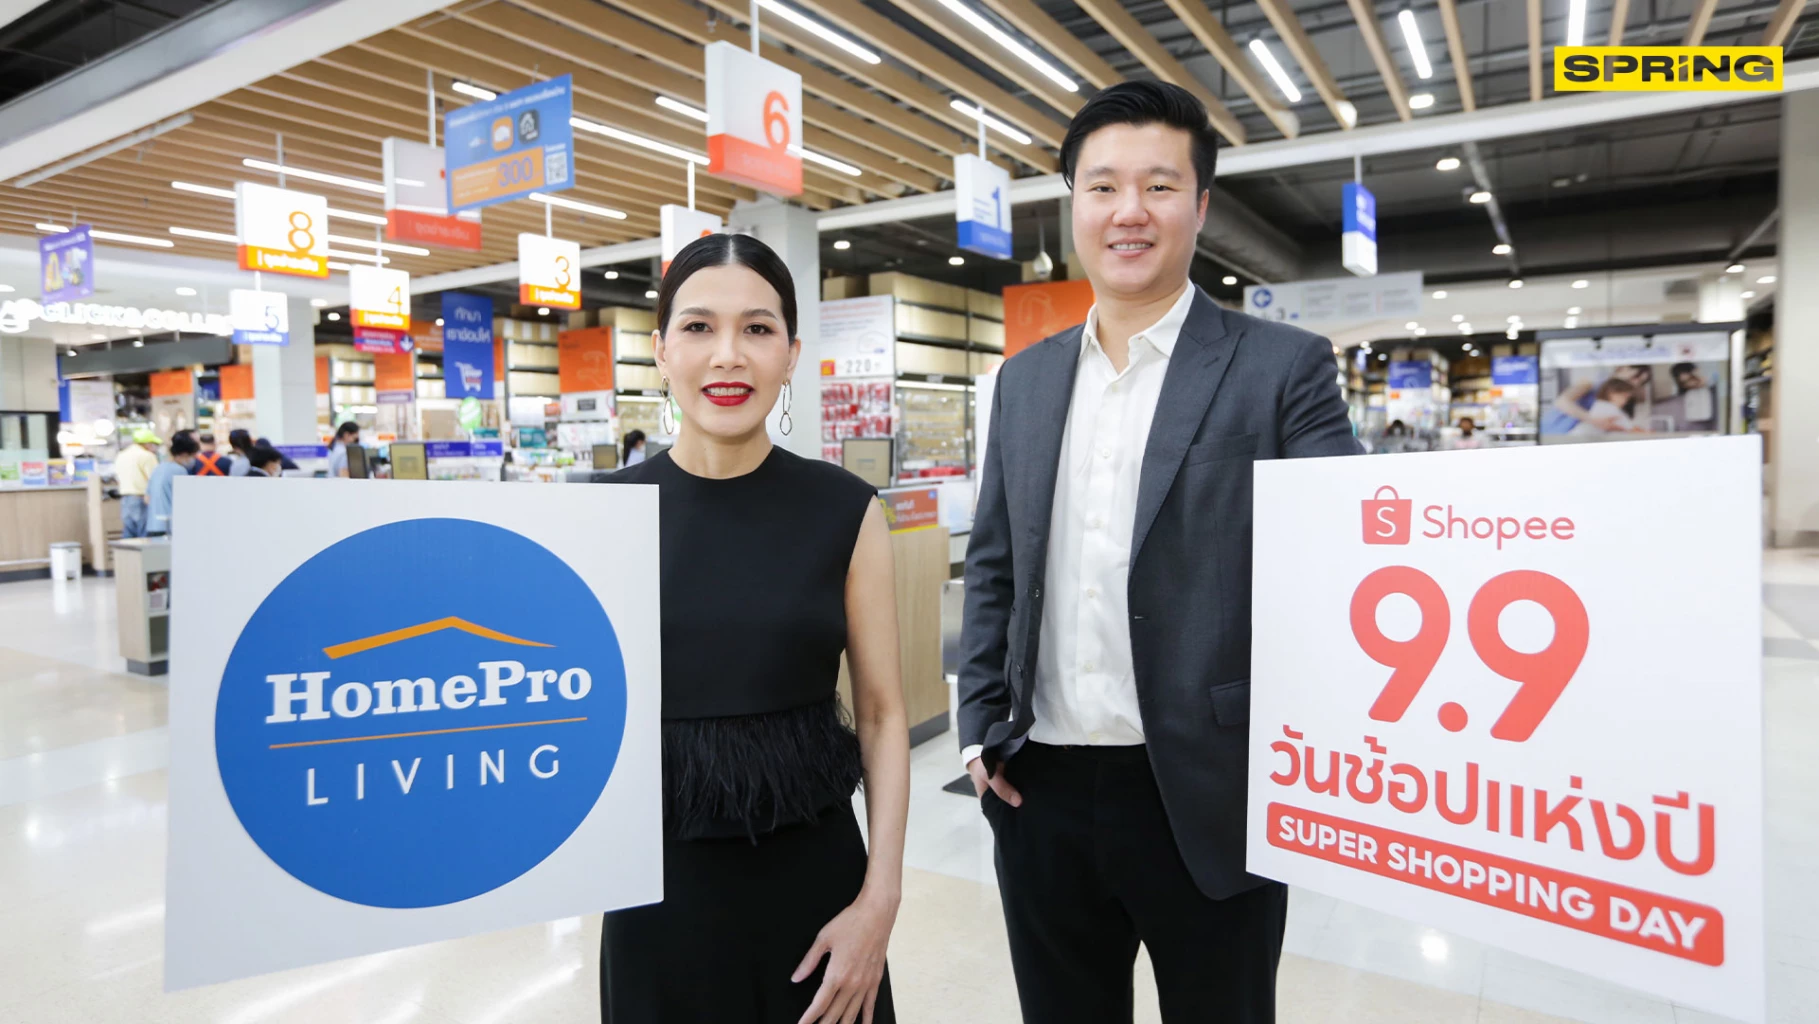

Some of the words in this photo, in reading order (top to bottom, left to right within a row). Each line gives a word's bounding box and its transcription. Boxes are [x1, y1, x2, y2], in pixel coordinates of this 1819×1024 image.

[763, 90, 790, 151] 6
[497, 156, 534, 187] 300
[287, 211, 315, 251] 8
[991, 186, 1002, 229] 1
[555, 256, 571, 287] 3
[264, 305, 280, 331] 5
[387, 286, 402, 314] 4
[1422, 504, 1576, 551] Shopee
[1349, 564, 1591, 743] 9.9
[264, 660, 593, 725] HomePro
[306, 744, 560, 806] LIVING
[1268, 723, 1716, 877] วันช้อปแห่งปี
[1278, 814, 1379, 864] SUPER
[1386, 840, 1595, 922] SHOPPING
[1608, 894, 1708, 951] DAY
